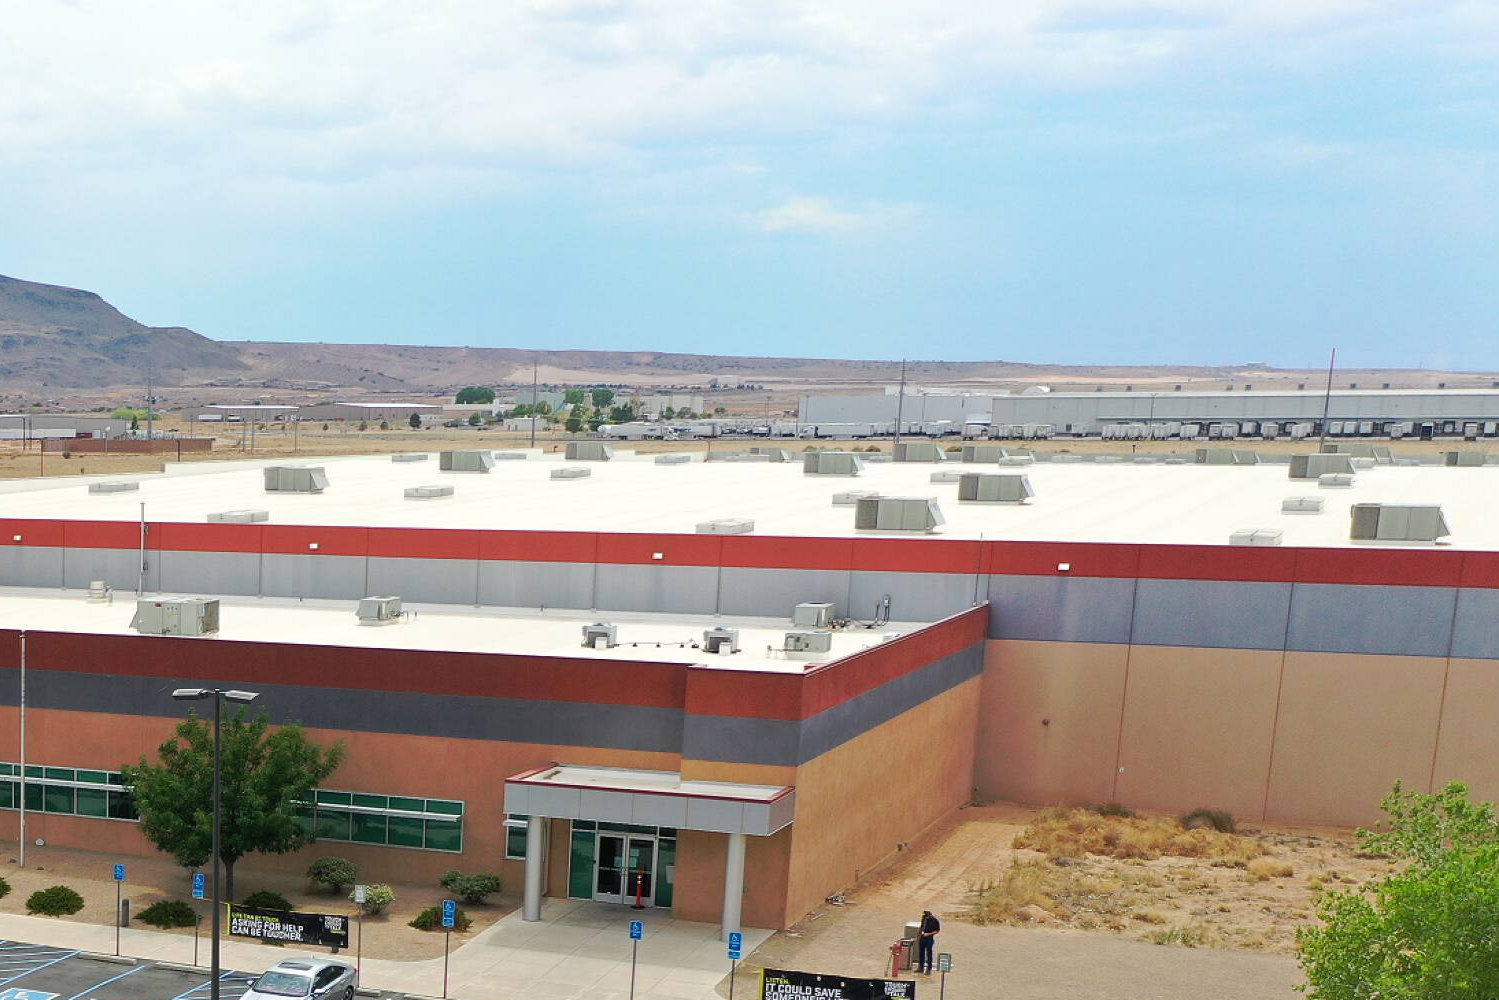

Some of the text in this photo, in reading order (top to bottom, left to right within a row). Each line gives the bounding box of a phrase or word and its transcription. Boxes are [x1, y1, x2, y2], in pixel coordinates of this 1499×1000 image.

[232, 918, 304, 933] ASKING FOR HELP
[232, 926, 249, 935] CAN
[250, 928, 261, 937] BE
[765, 983, 842, 998] IT COULD SAVE
